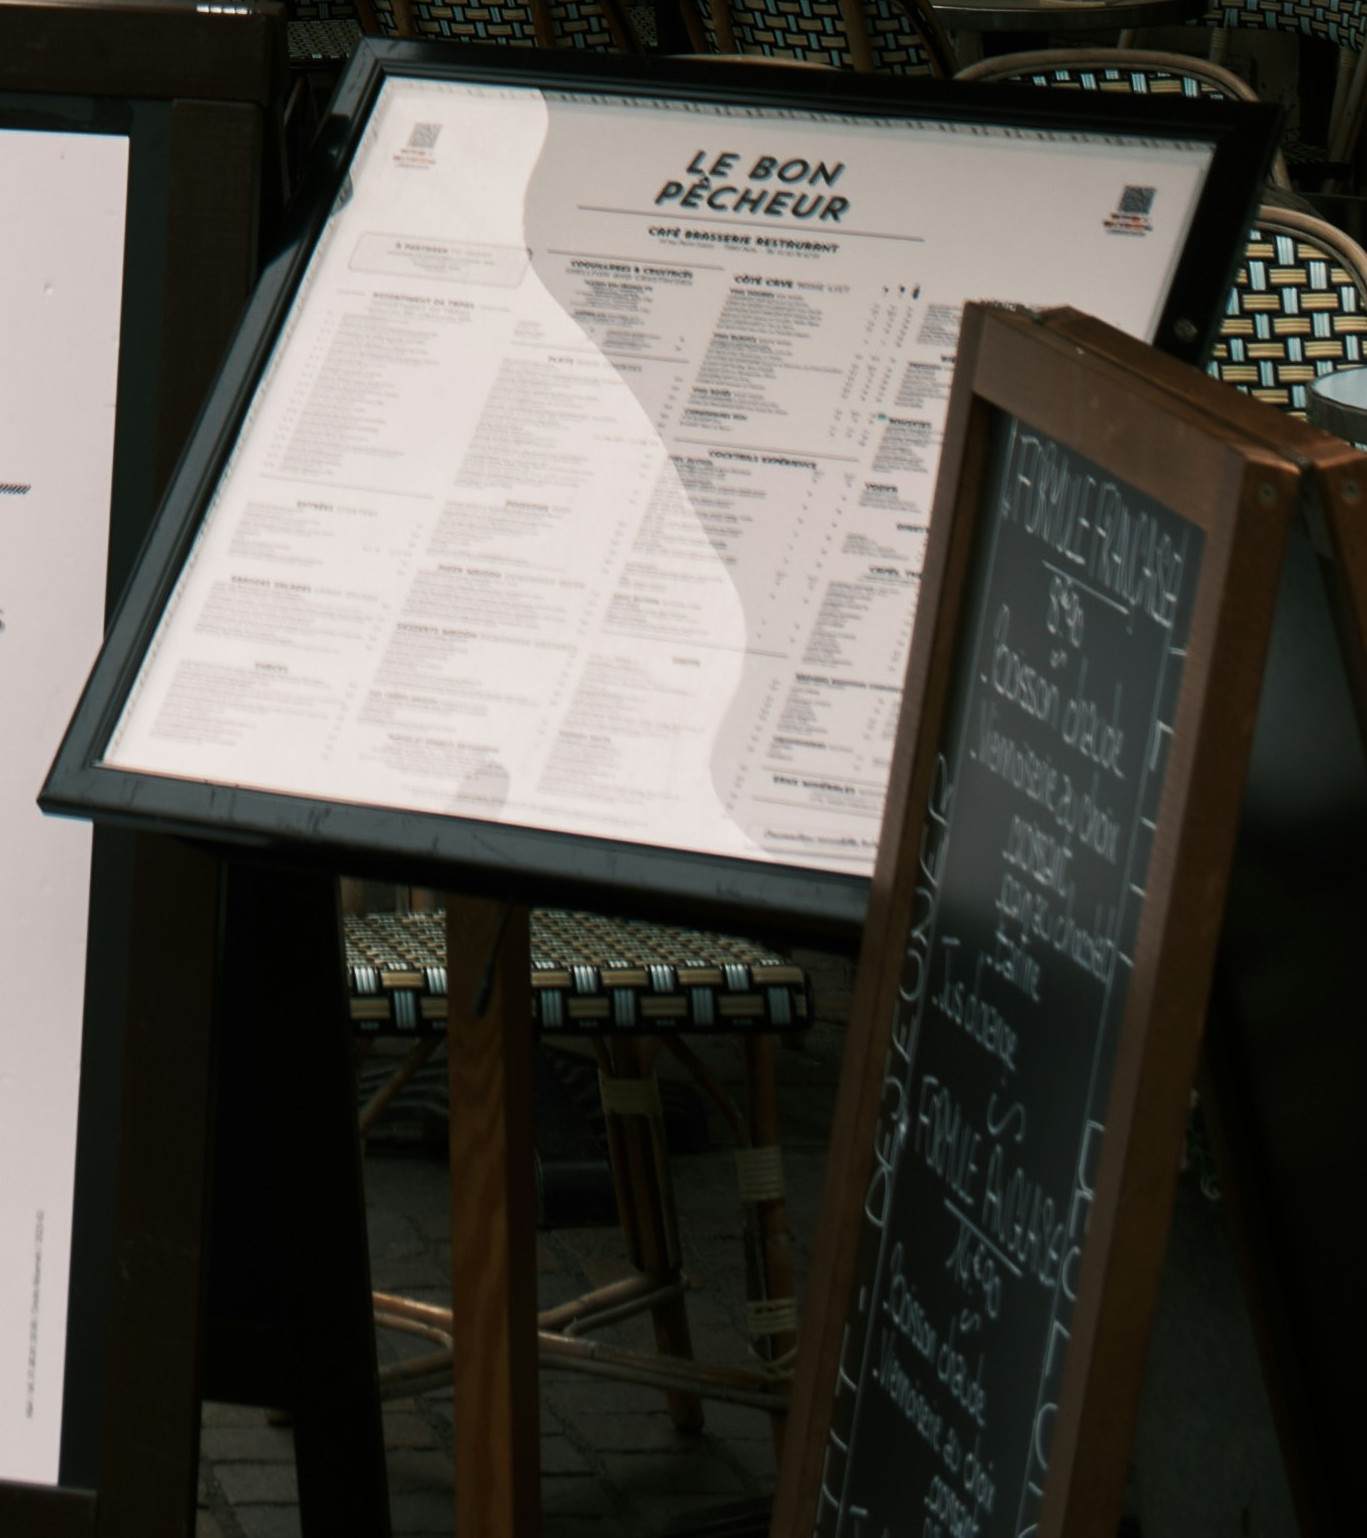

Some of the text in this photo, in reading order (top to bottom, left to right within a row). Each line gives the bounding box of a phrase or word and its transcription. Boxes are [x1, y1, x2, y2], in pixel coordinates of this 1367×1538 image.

[685, 150, 846, 187] LE BON
[654, 175, 851, 224] PÊCHEUR
[684, 229, 752, 246] BRASSERIE
[755, 236, 840, 255] RESTAURANT
